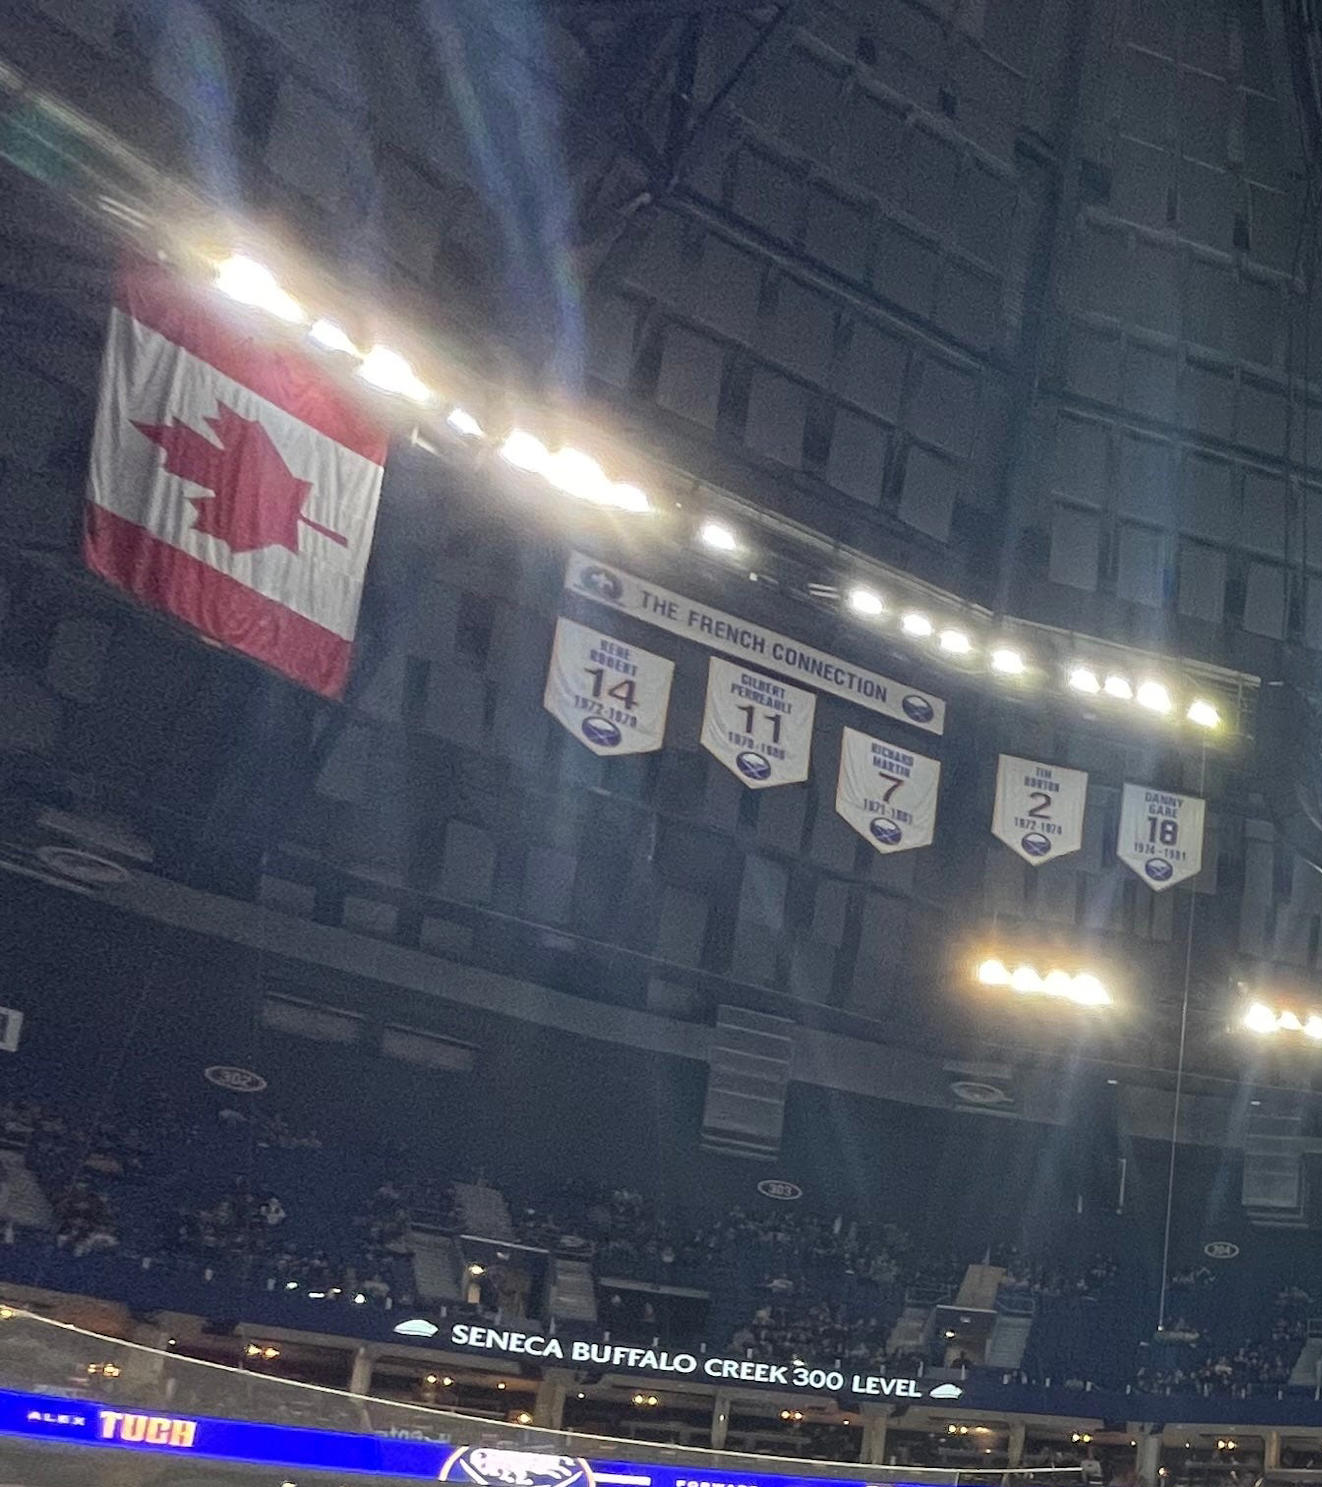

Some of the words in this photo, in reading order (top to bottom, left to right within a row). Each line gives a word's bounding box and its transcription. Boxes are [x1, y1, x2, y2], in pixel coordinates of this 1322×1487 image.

[640, 590, 678, 621] THE
[687, 611, 766, 655] FRENCH
[771, 643, 888, 703] CONNECTION
[584, 667, 638, 710] 14
[736, 703, 783, 744] 11
[879, 772, 903, 802] 7
[1028, 792, 1052, 819] 2
[1147, 816, 1179, 845] 18
[451, 1324, 563, 1360] SENECA
[572, 1341, 696, 1373] BUFFALO
[704, 1357, 788, 1383] CREEK
[792, 1368, 843, 1390] 300
[851, 1375, 922, 1398] LEVEL
[27, 1410, 85, 1427] ALEX
[100, 1411, 197, 1446] TUCH
